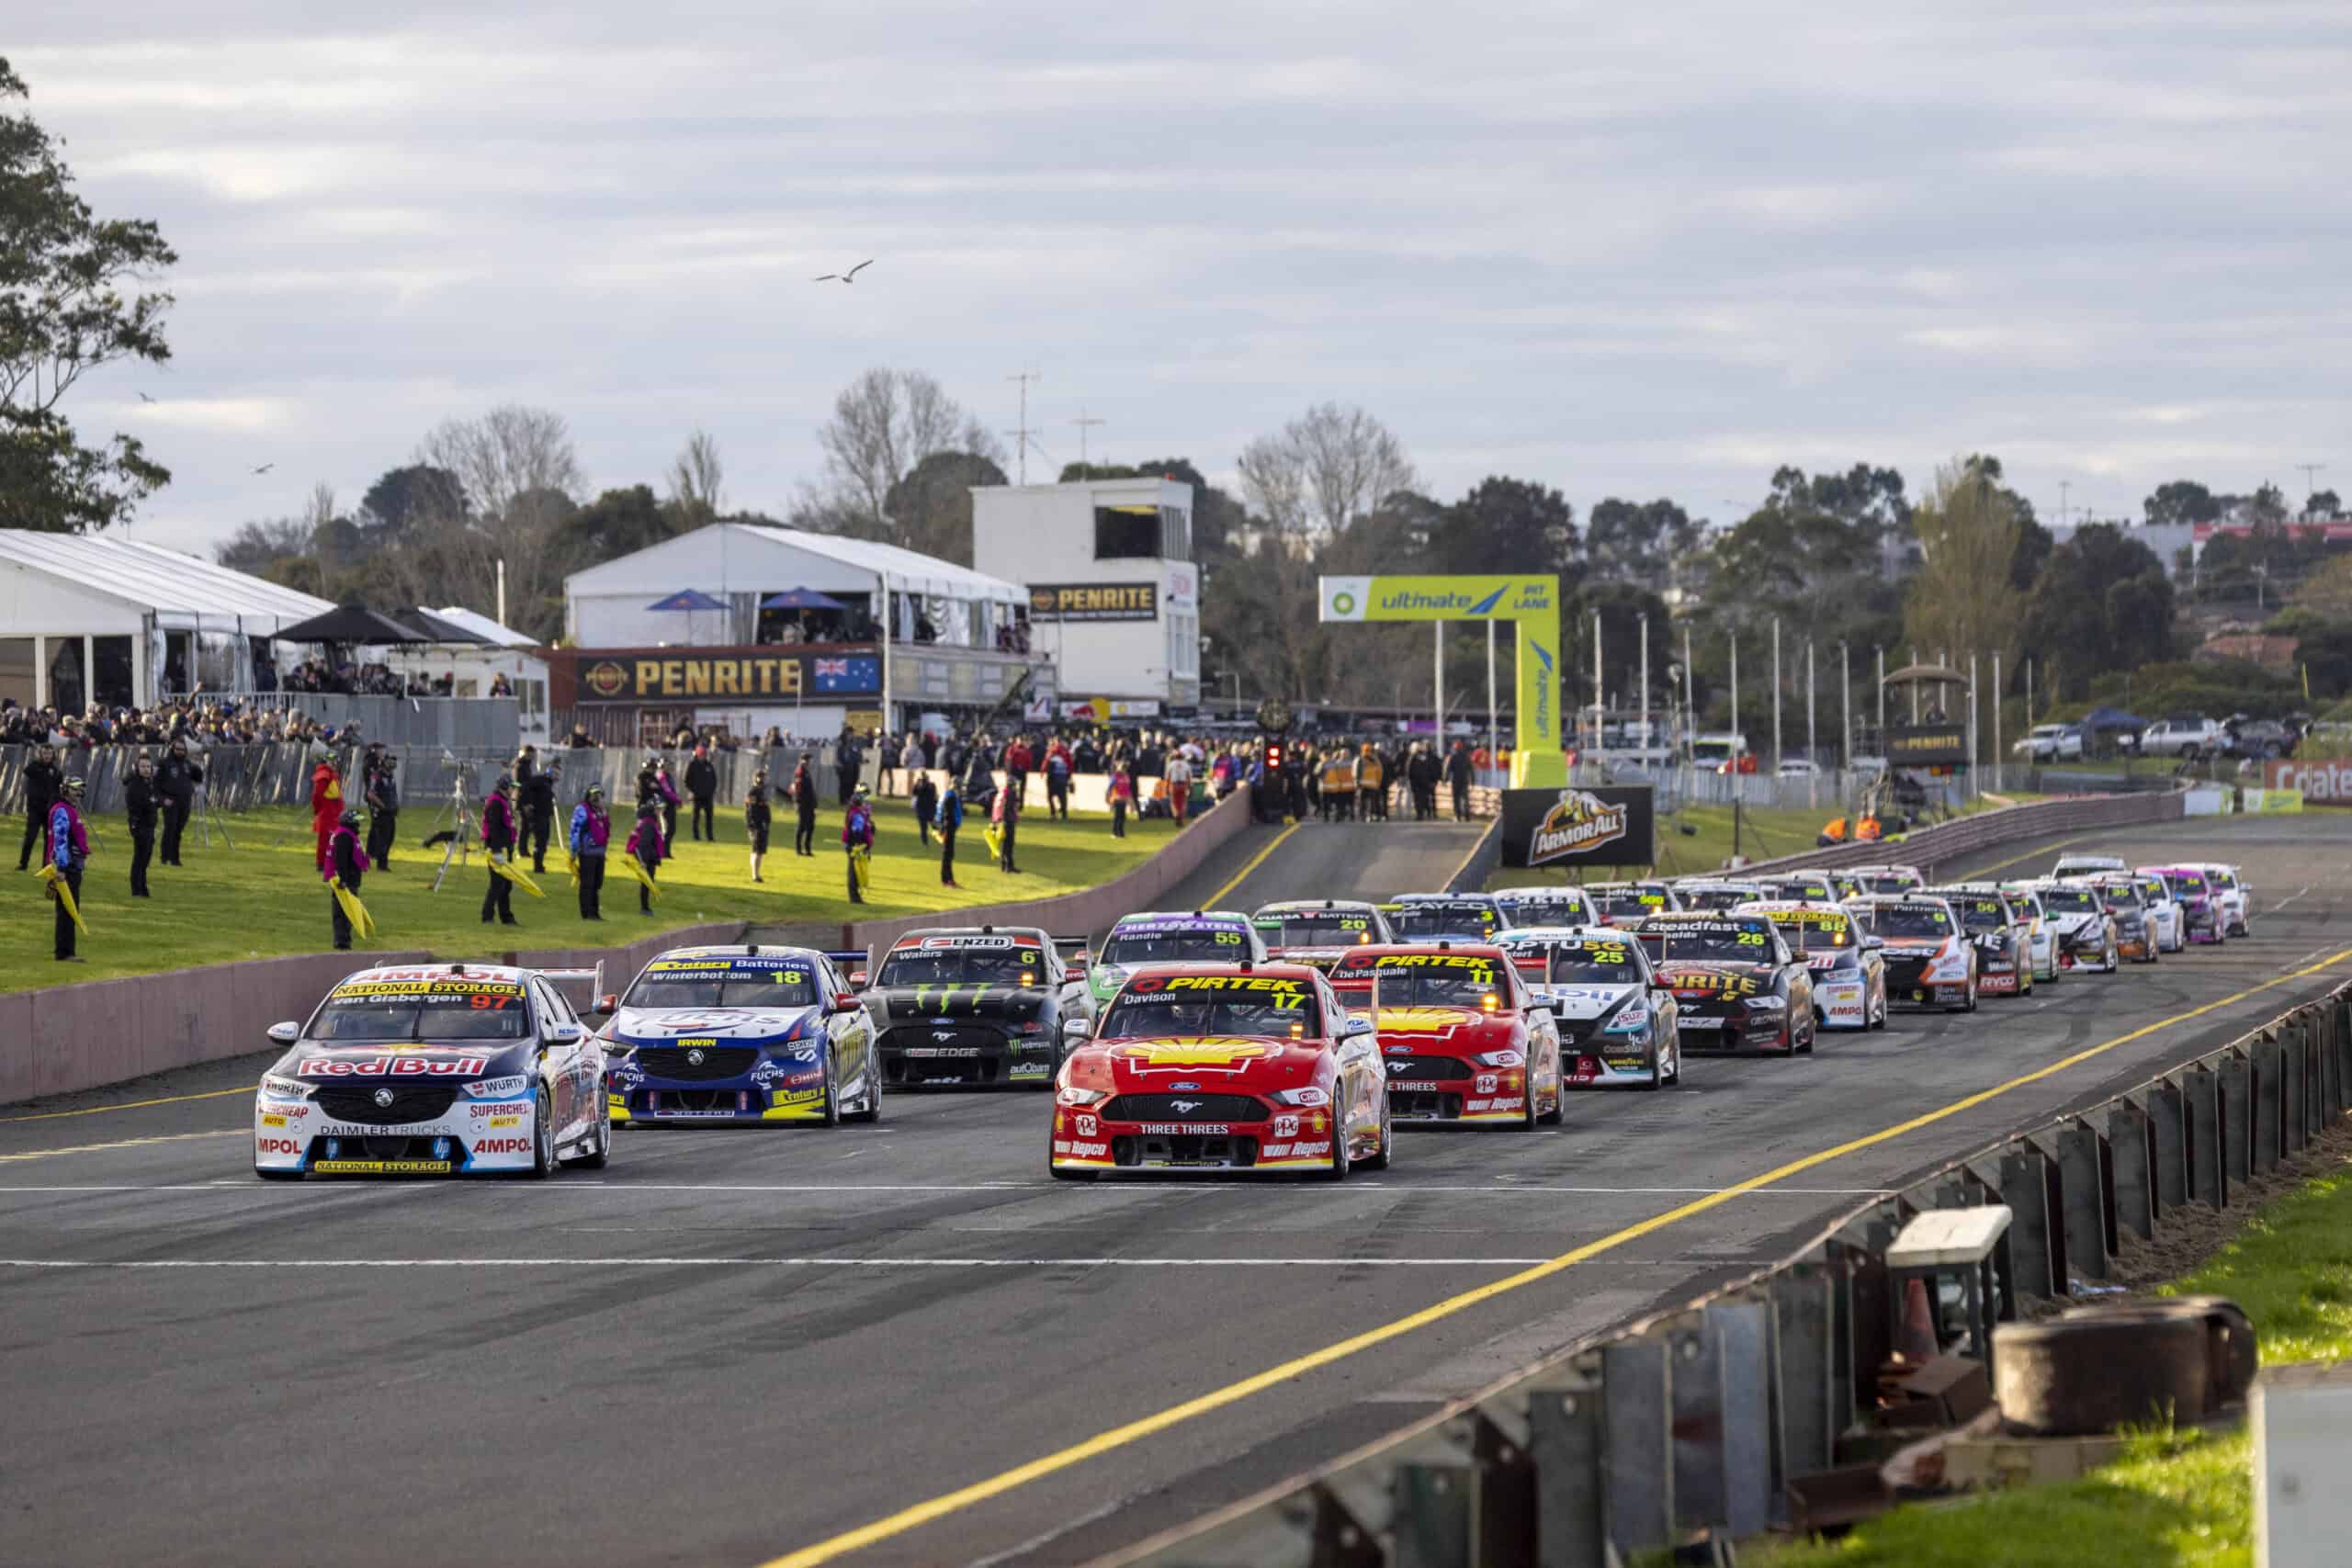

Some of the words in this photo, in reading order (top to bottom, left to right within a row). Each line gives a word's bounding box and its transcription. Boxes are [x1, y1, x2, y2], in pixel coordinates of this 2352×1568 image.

[1057, 587, 1154, 610] PENRITE
[1381, 592, 1472, 609] ultimate
[1514, 599, 1549, 609] LANE
[635, 659, 802, 695] PENRITE
[1480, 910, 1494, 921] 3
[1340, 919, 1367, 930] 20
[1646, 920, 1741, 931] Steadfast
[1818, 920, 1848, 932] 88
[952, 937, 1006, 947] ENZED
[1215, 931, 1242, 945] 55
[1736, 931, 1765, 945] 26
[899, 950, 944, 961] Waters
[1020, 950, 1037, 964] 6
[1375, 955, 1497, 969] PIRTEK
[1592, 950, 1625, 964] 25
[735, 959, 810, 970] Batteries
[770, 970, 802, 985] 18
[1166, 976, 1305, 993] PIRTEK
[1340, 969, 1354, 979] De
[1470, 969, 1494, 986] 11
[337, 983, 425, 996] NATIONAL
[434, 983, 518, 995] STORAGE
[334, 996, 365, 1006] van
[368, 994, 463, 1004] Gisbergen
[470, 994, 513, 1010] 97
[1125, 992, 1177, 1005] Davison
[1271, 992, 1308, 1010] 17
[676, 1038, 718, 1047] IRWIN
[938, 1047, 980, 1057] EDGE
[297, 1056, 390, 1077] Red
[390, 1056, 490, 1077] Bull
[751, 1068, 786, 1082] FUCHS
[1396, 1081, 1437, 1091] THREES
[321, 1125, 390, 1136] DAIMLER
[392, 1124, 451, 1135] TRUCKS
[1140, 1123, 1180, 1134] THREE
[1182, 1123, 1228, 1134] THREES
[1275, 1117, 1298, 1135] PPG
[258, 1138, 302, 1155] MPOL
[472, 1138, 533, 1154] AMPOL
[1071, 1140, 1107, 1157] Repco
[1291, 1141, 1330, 1157] Repco
[316, 1161, 379, 1171] NATIONAL
[384, 1161, 447, 1171] STORAGE
